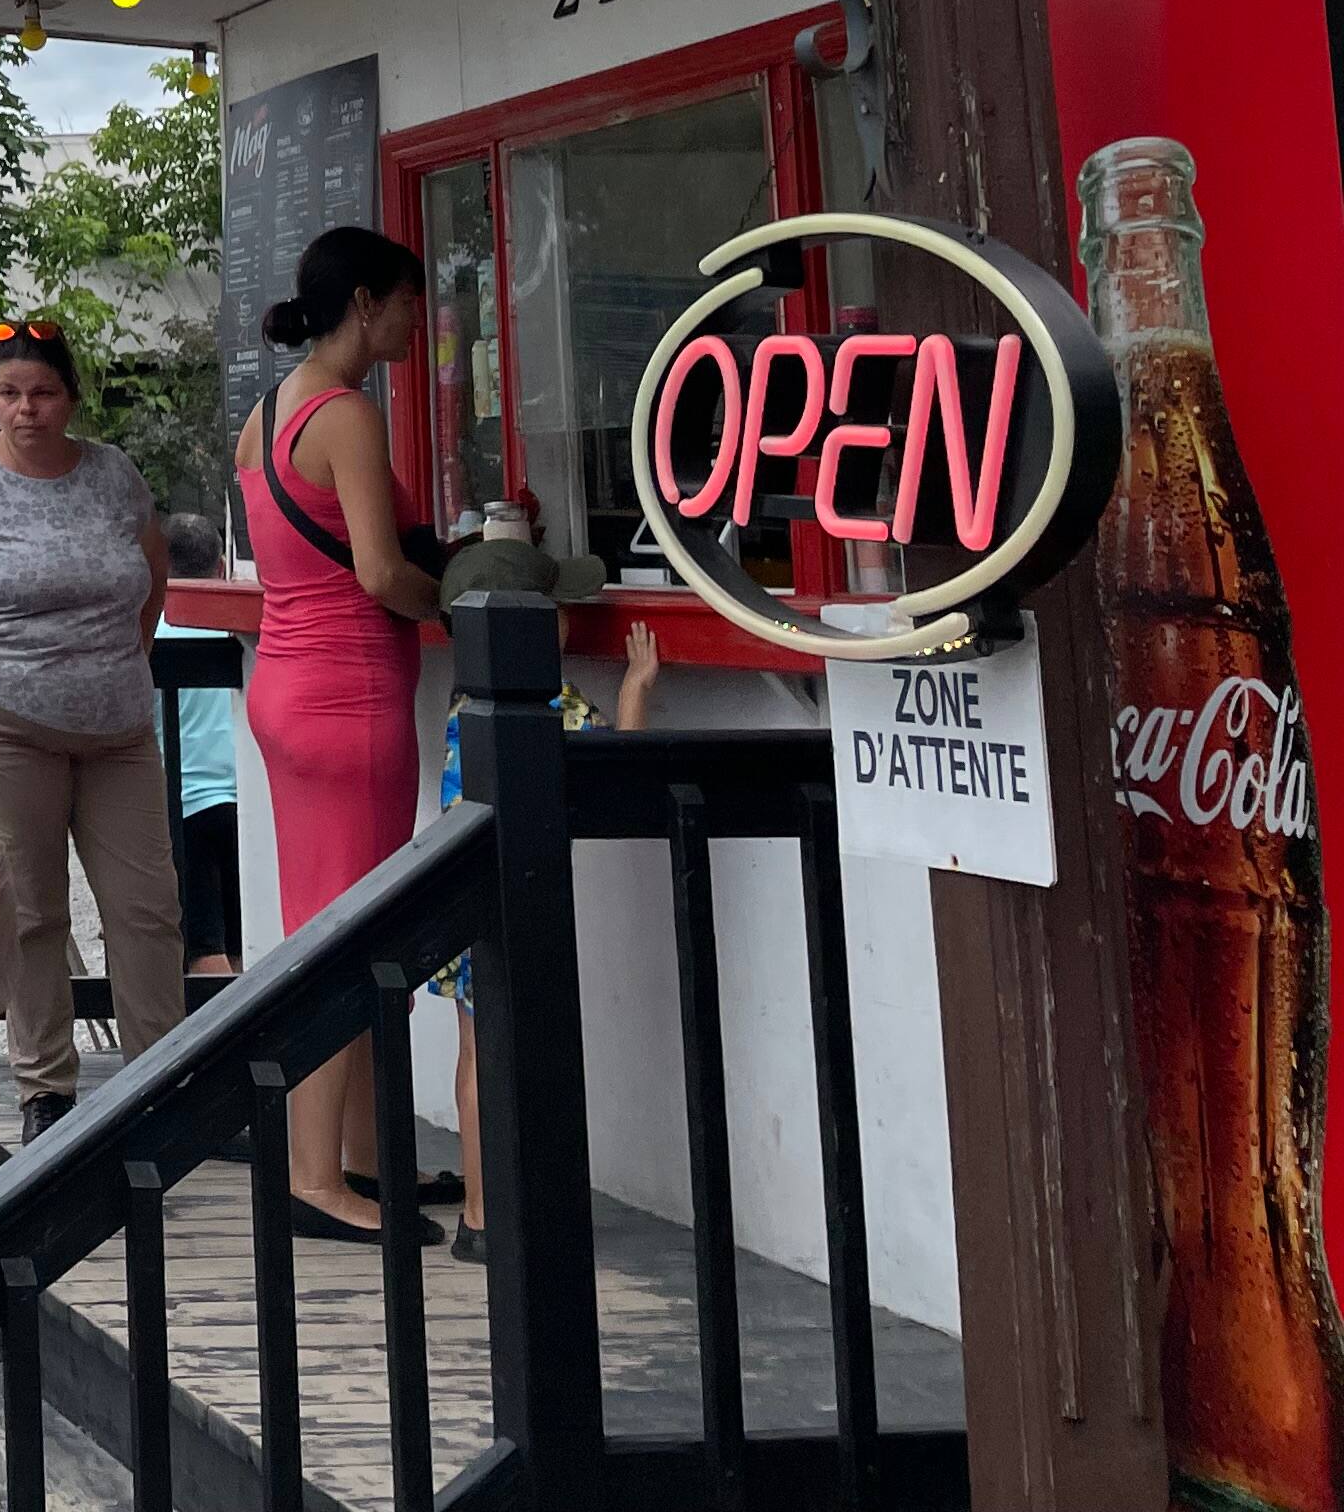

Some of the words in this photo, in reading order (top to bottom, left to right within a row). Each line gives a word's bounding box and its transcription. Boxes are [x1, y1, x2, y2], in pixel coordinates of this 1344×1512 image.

[230, 120, 273, 178] Mag
[655, 333, 1022, 552] OPEN
[892, 668, 983, 730] ZONE
[854, 730, 1031, 804] D'ATTENTE
[1110, 676, 1310, 838] ca-Cola
